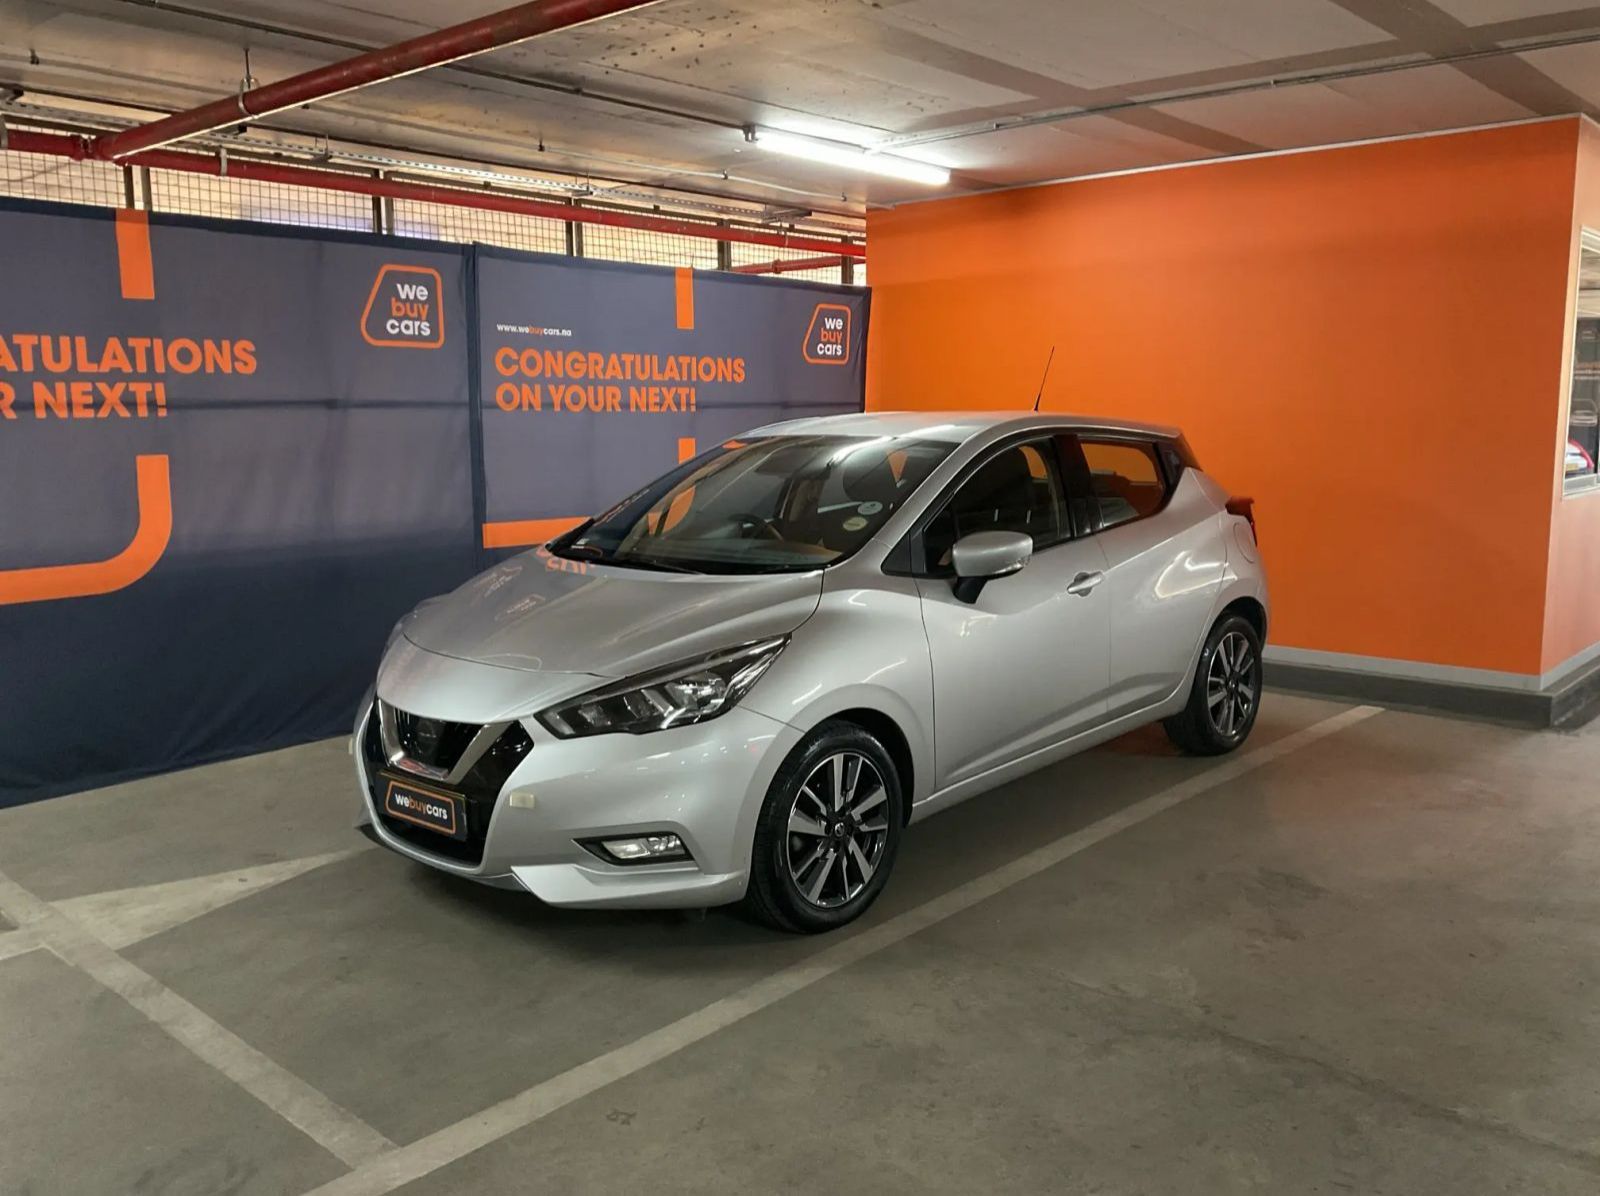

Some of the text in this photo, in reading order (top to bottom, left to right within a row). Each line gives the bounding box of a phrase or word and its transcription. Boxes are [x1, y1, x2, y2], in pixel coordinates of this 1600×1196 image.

[396, 283, 429, 301] we
[391, 297, 429, 321] buy
[386, 319, 431, 336] cars
[824, 317, 843, 330] we
[821, 327, 842, 344] buy
[817, 343, 842, 356] cars
[494, 346, 746, 383] CONGRATULATIONS
[32, 381, 168, 419] NEXT!
[495, 382, 697, 412] ON YOUR NEXT!
[394, 793, 448, 820] webuycars
